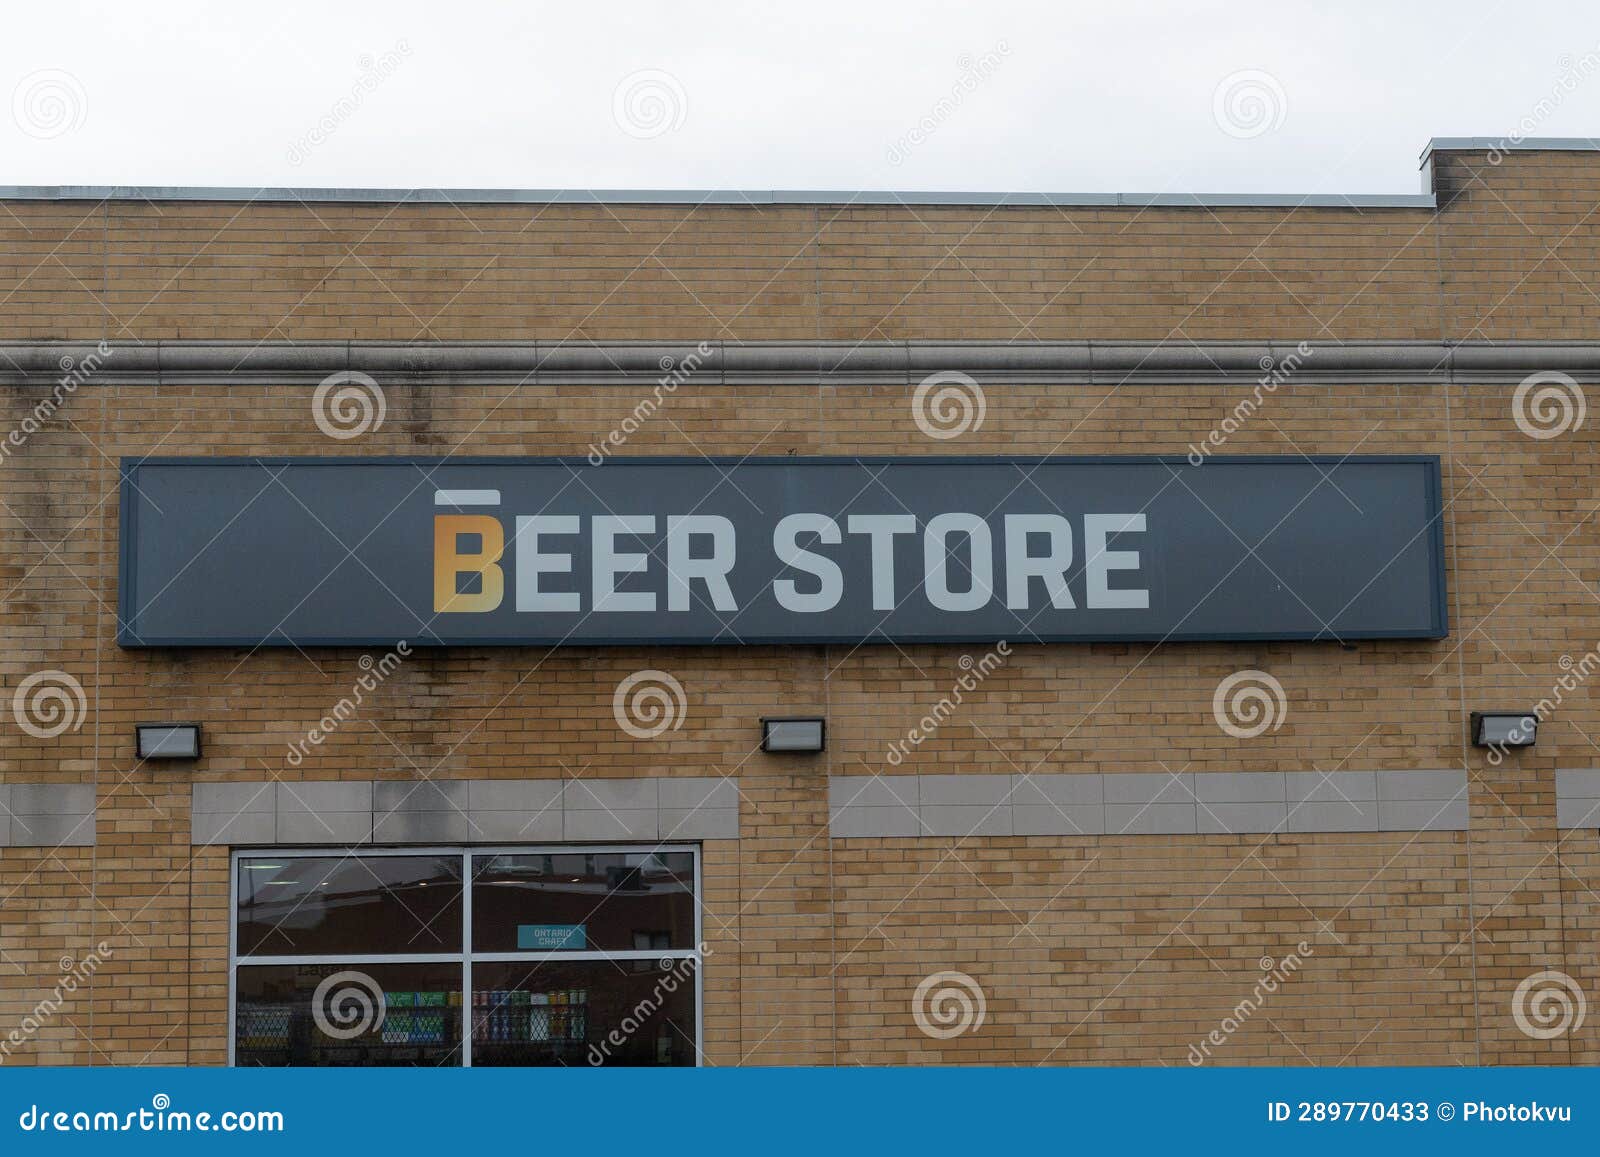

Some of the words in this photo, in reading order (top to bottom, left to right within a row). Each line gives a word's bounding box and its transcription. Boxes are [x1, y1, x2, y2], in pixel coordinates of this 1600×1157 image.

[434, 513, 738, 613] BEER
[773, 512, 1149, 612] STORE
[534, 928, 572, 937] ONTARIO
